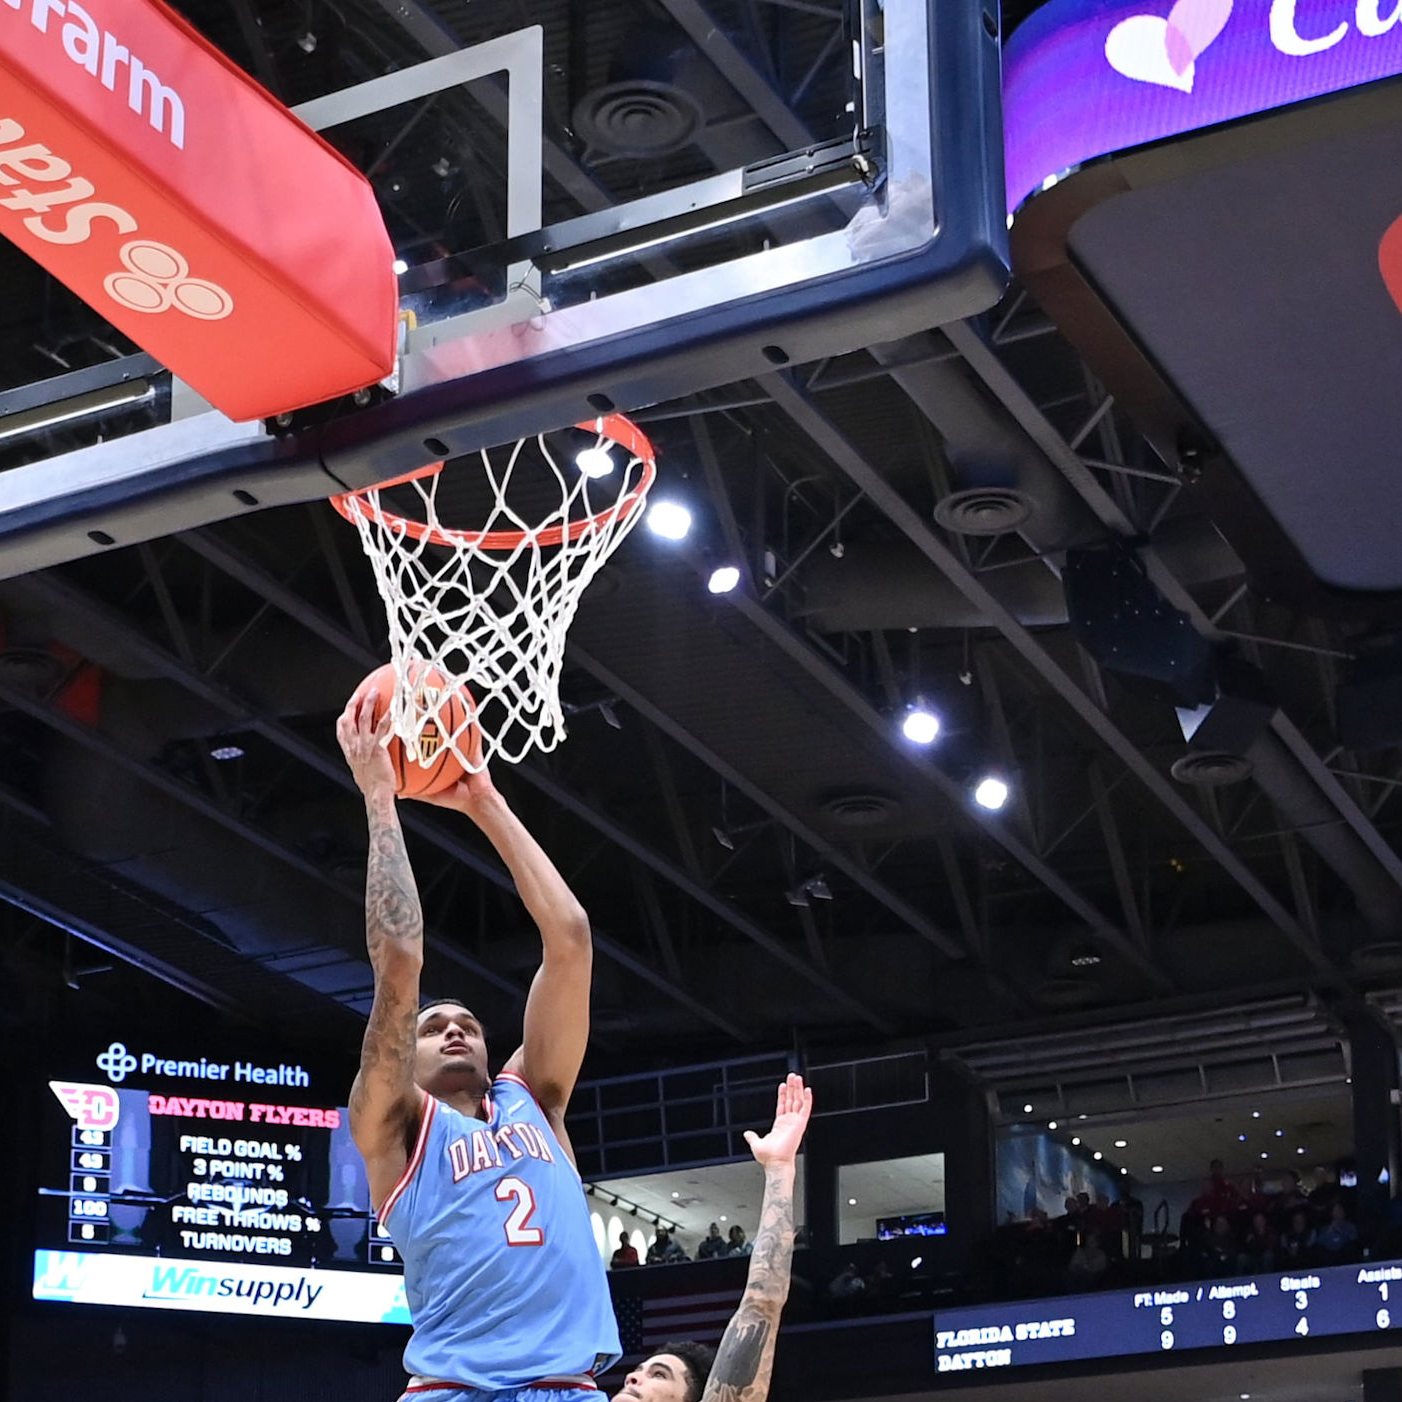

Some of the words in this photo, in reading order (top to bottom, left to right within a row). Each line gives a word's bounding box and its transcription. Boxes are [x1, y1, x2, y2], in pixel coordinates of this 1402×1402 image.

[141, 1053, 229, 1081] Premier
[235, 1062, 310, 1087] Health
[149, 1095, 244, 1121] DAYTON
[249, 1103, 341, 1129] FLYERS
[180, 1135, 231, 1156] FIELD
[234, 1140, 282, 1160] GOAL
[285, 1144, 302, 1161] %
[449, 1122, 556, 1184] DAYTON
[193, 1161, 207, 1176] 3
[209, 1163, 265, 1180] POINT
[267, 1165, 284, 1182] %
[187, 1182, 288, 1207] REBOUNDS
[172, 1206, 218, 1226] FREE
[222, 1210, 302, 1232] THROWS
[305, 1217, 321, 1232] %
[494, 1176, 545, 1246] 2
[180, 1231, 292, 1256] TURNOVERS
[152, 1265, 324, 1310] Winsupply
[1280, 1274, 1320, 1292] Steals
[1154, 1290, 1189, 1306] Made
[1160, 1308, 1173, 1325] 5
[1223, 1301, 1236, 1319] 8
[1295, 1291, 1308, 1310] 3
[1378, 1282, 1389, 1301] 1
[937, 1324, 1013, 1349] FLORIDA
[1015, 1318, 1075, 1341] STATE
[1161, 1331, 1174, 1350] 9
[1223, 1326, 1236, 1345] 9
[1295, 1317, 1309, 1336] 4
[1376, 1309, 1390, 1329] 6
[937, 1348, 1011, 1372] DAYTON
